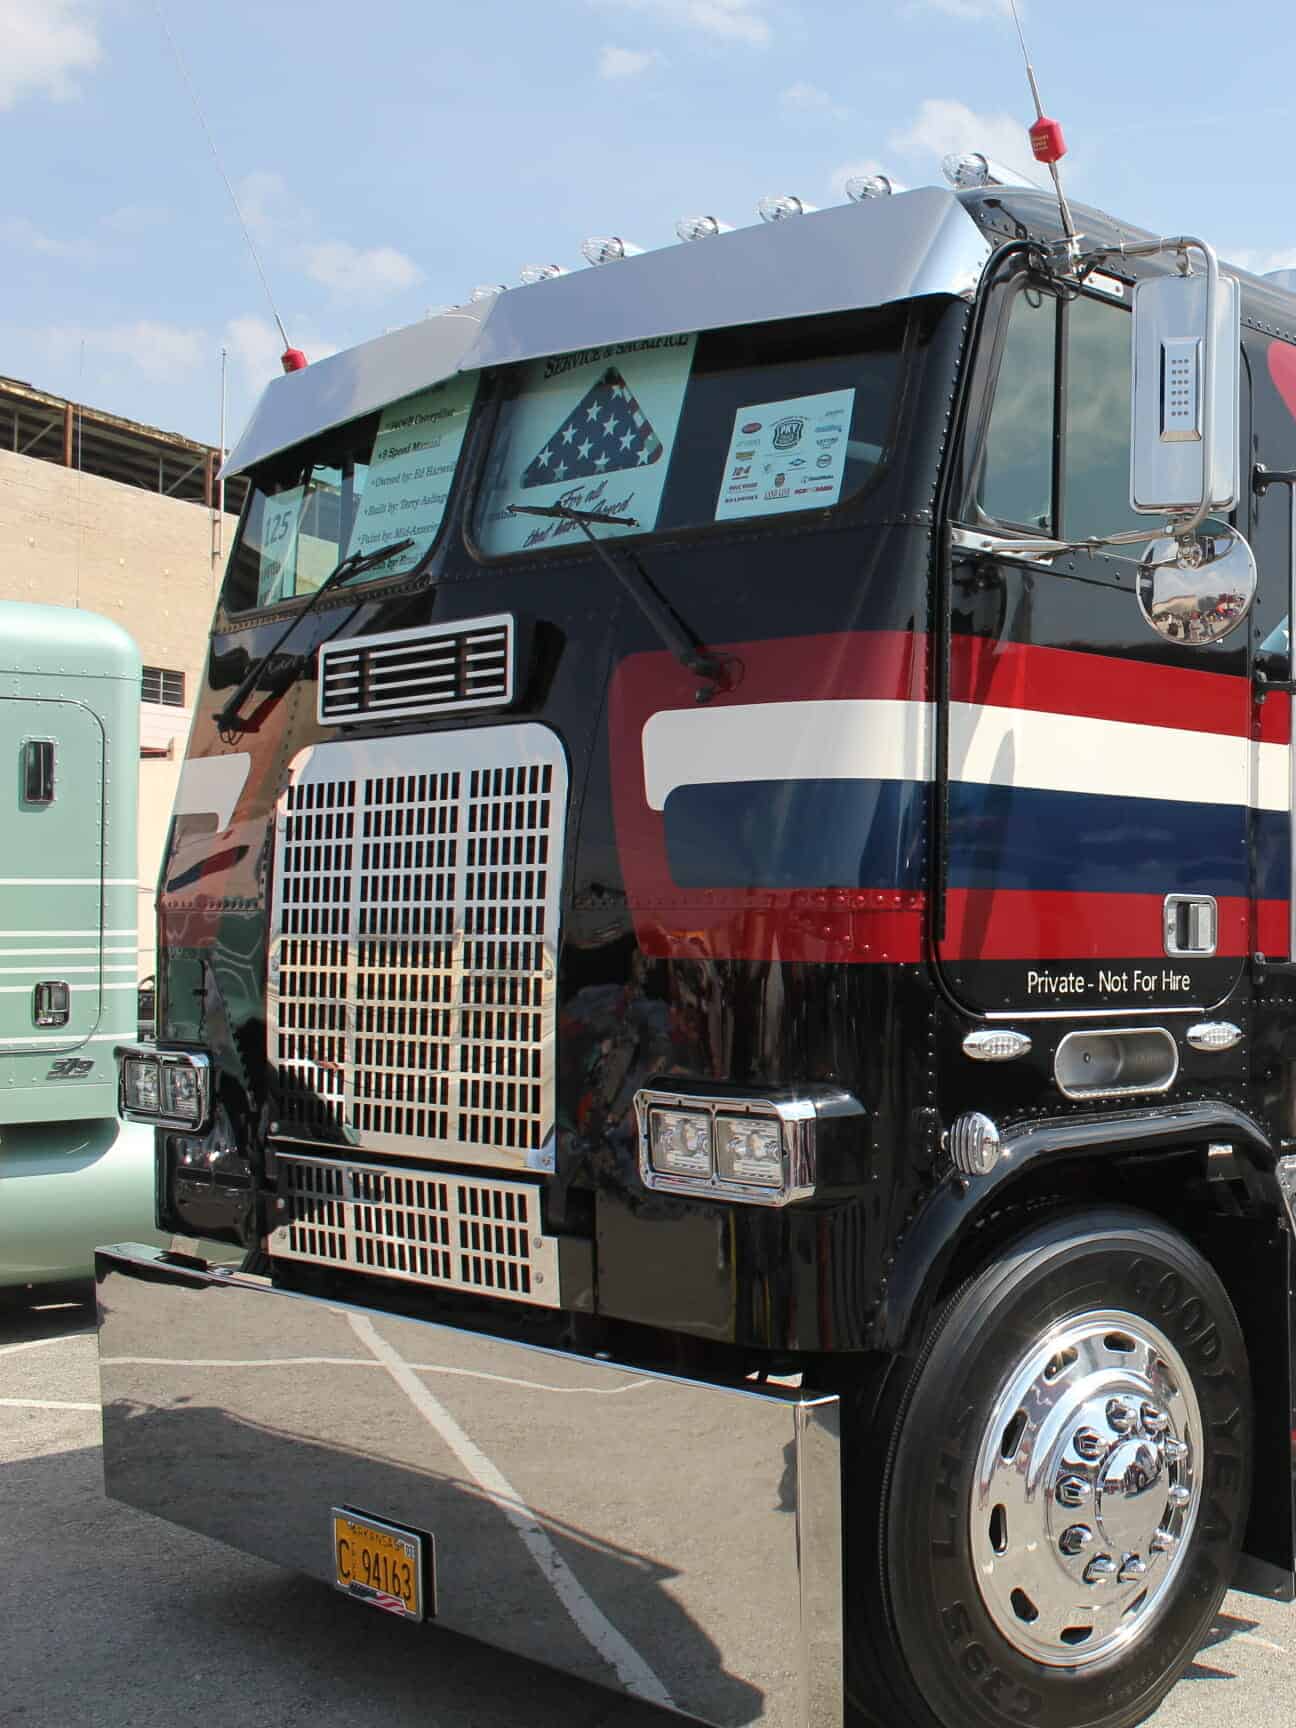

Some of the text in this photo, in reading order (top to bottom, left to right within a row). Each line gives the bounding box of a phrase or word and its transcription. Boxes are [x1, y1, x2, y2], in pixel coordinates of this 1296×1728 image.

[265, 510, 292, 547] 125
[1027, 970, 1085, 994] Private
[1099, 970, 1129, 992] Not
[1133, 970, 1157, 991] For
[1162, 969, 1191, 991] Hire
[338, 1538, 412, 1601] C 94163
